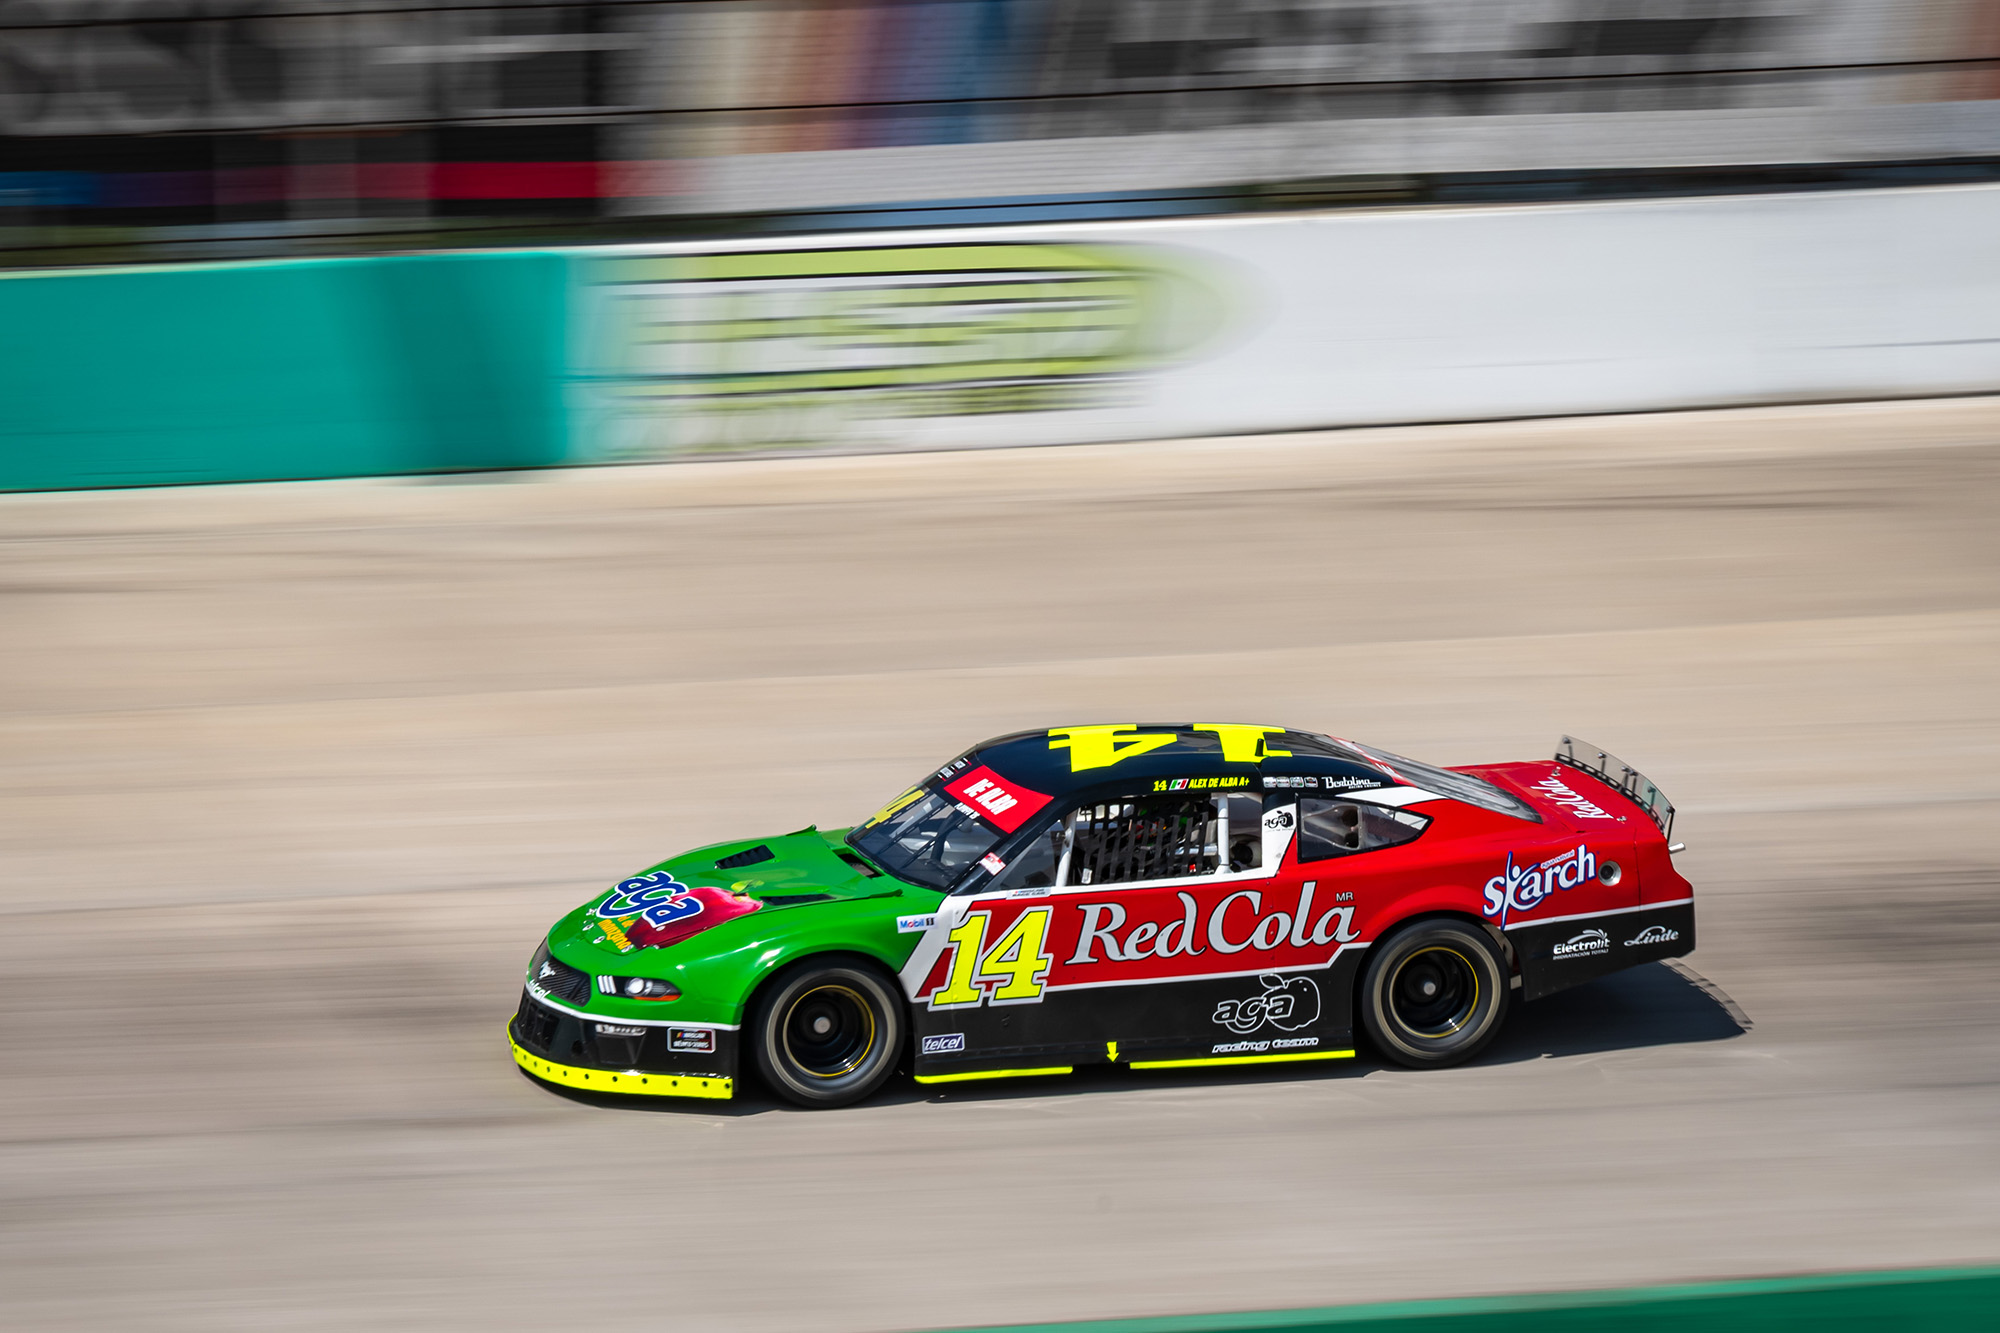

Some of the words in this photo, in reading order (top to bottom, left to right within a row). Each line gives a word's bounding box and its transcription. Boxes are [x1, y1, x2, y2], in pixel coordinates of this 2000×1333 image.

[963, 778, 994, 798] DE
[1153, 780, 1167, 791] 14
[1188, 778, 1208, 788] ALEX
[1208, 778, 1219, 788] DE
[1219, 777, 1238, 787] ALBA
[1239, 776, 1250, 786] A+
[975, 787, 1018, 815] ALBA
[595, 870, 705, 928] aga
[1336, 892, 1354, 901] MR
[900, 919, 924, 929] Mobil
[1624, 925, 1679, 946] Linde
[1553, 938, 1610, 955] Electrolit
[928, 905, 1054, 1012] 14
[1212, 996, 1294, 1034] aga
[925, 1036, 961, 1050] telcel
[1212, 1041, 1270, 1053] racing
[1272, 1038, 1319, 1049] team
